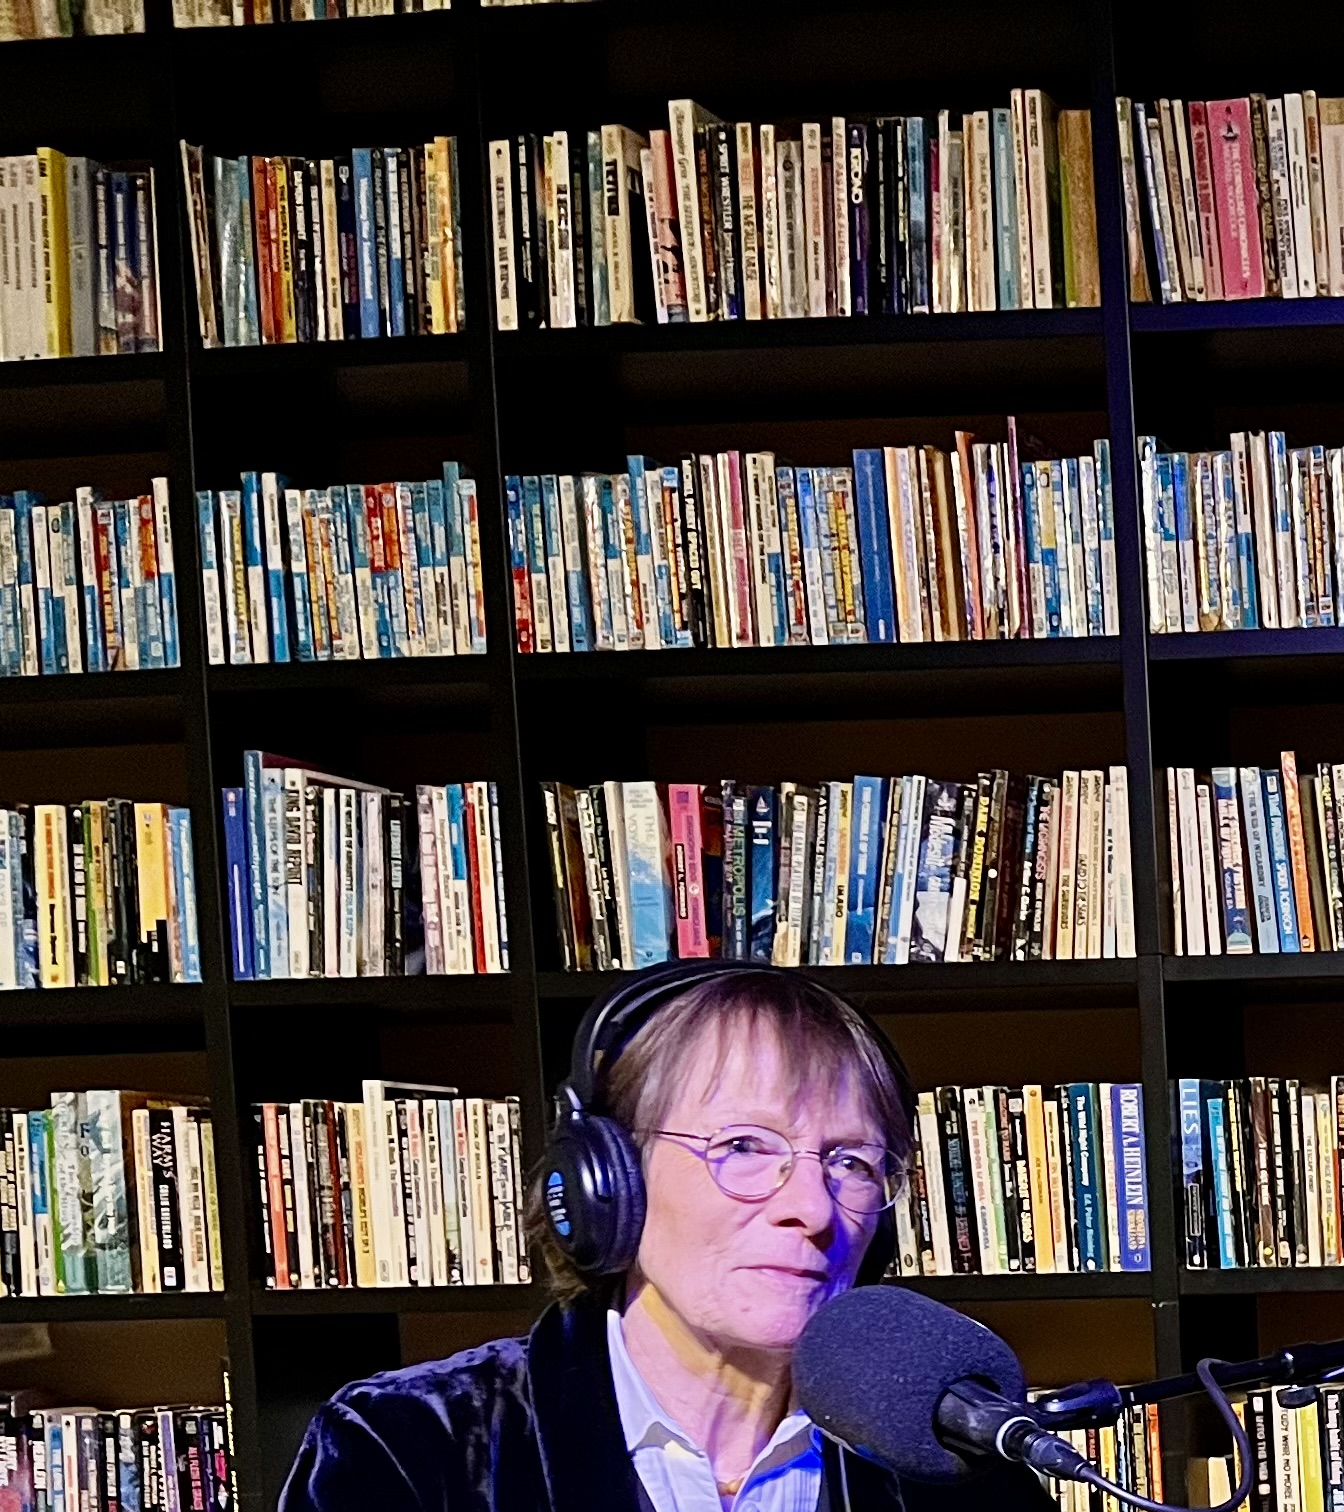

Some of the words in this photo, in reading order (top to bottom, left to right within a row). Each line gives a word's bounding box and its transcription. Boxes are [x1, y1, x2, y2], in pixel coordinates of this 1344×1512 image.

[721, 176, 732, 229] WRESTLER
[977, 796, 990, 833] DARK
[733, 824, 745, 916] METROPOLIS
[970, 837, 984, 901] DOMINION
[836, 885, 845, 918] IMARO
[1120, 1090, 1140, 1132] ROBERT
[1183, 1088, 1198, 1135] LIES
[152, 1133, 165, 1167] WAY
[161, 1122, 176, 1179] HARM'S
[1123, 1134, 1139, 1147] A.
[1125, 1148, 1144, 1206] HEINLEIN
